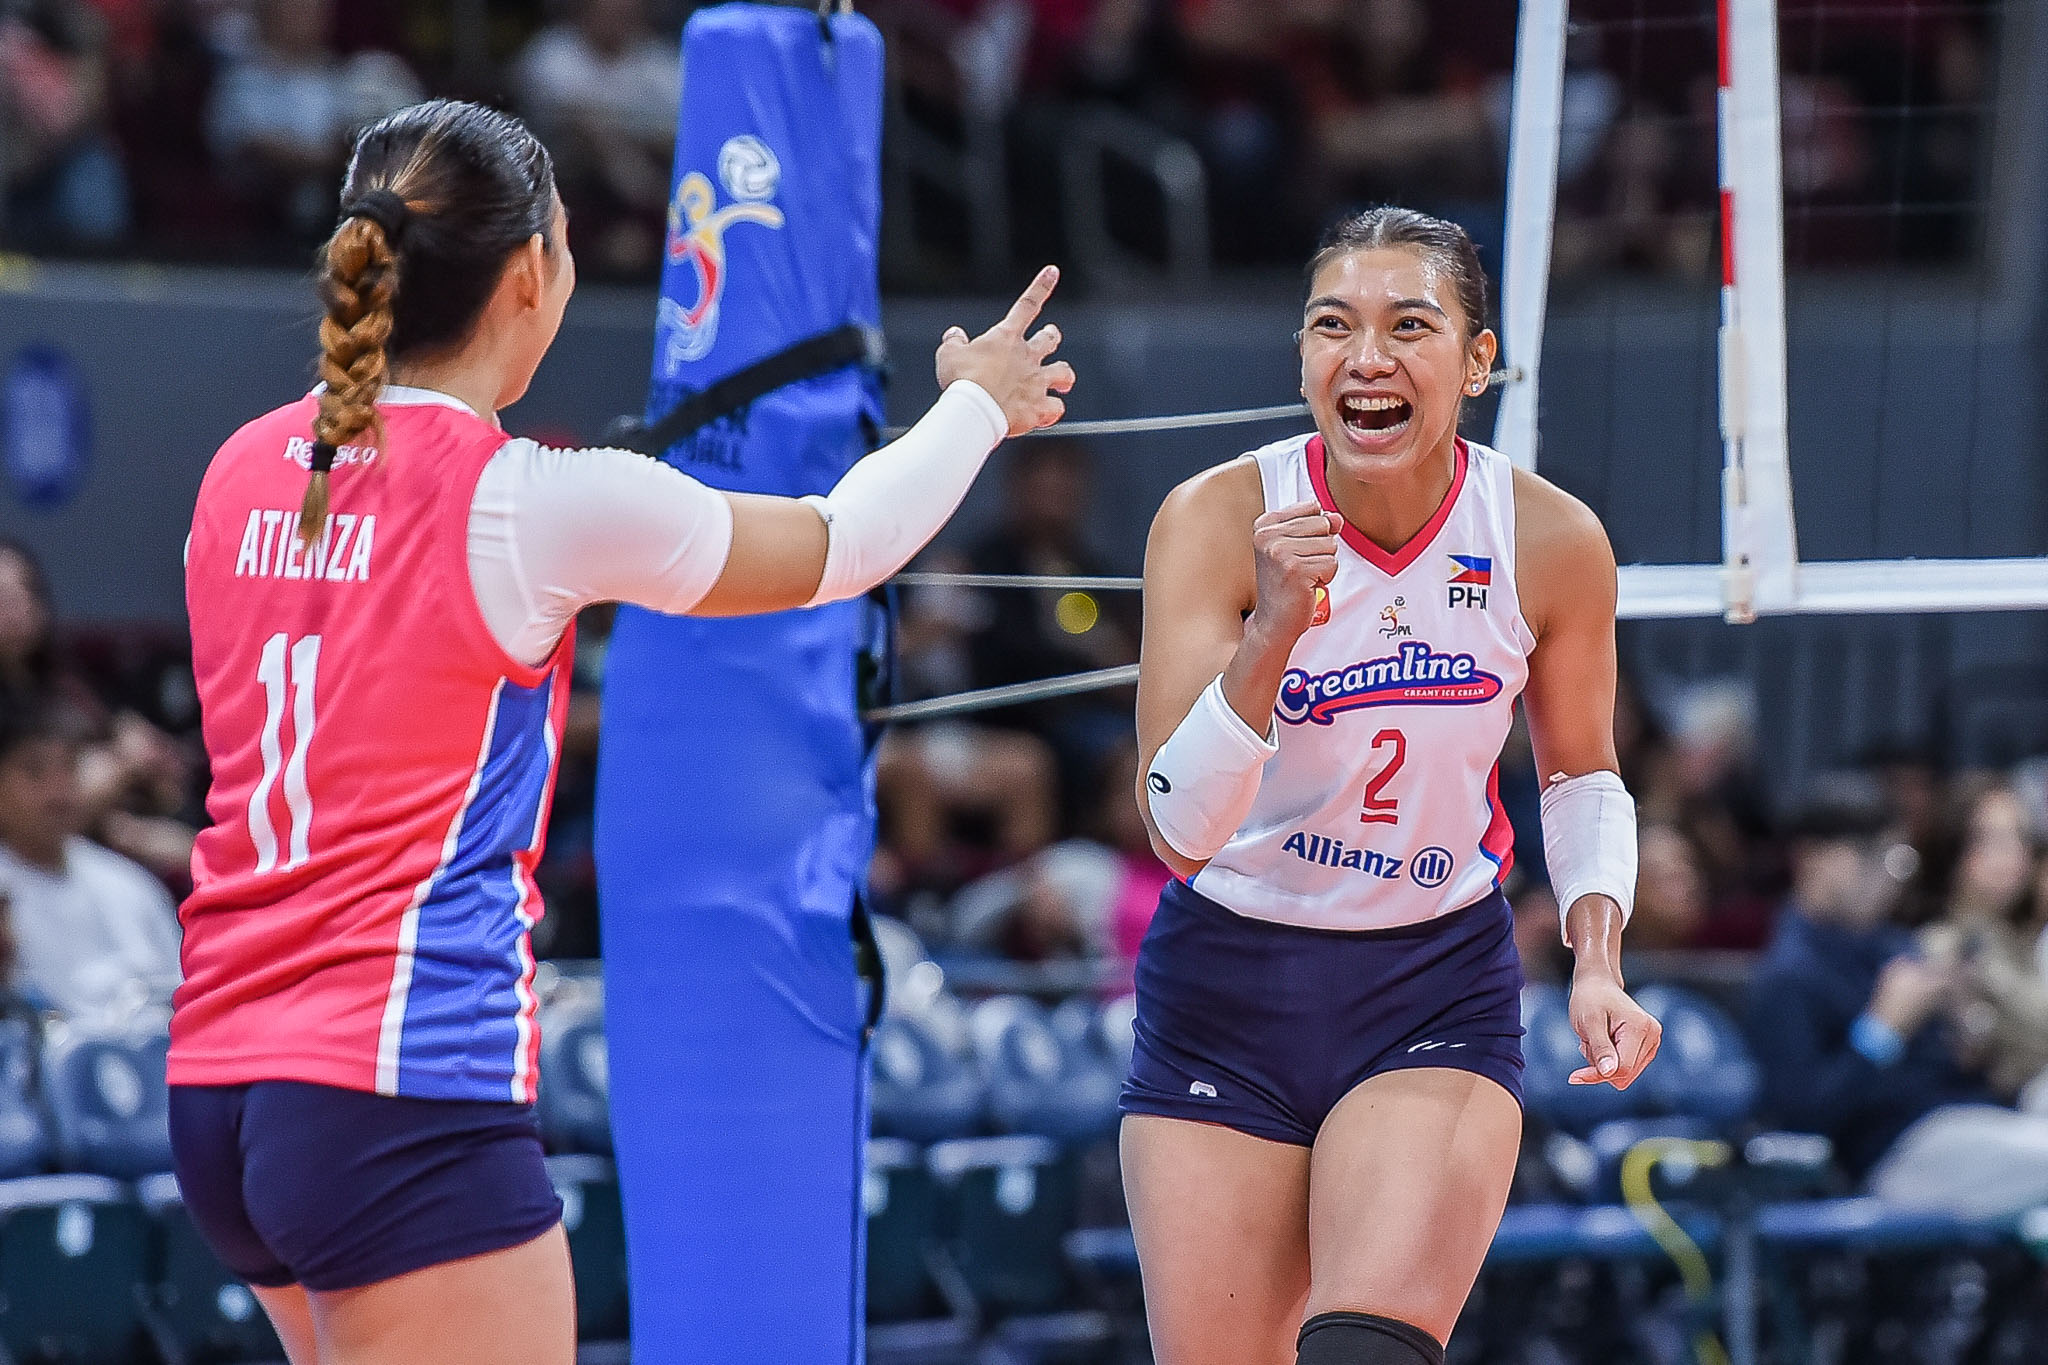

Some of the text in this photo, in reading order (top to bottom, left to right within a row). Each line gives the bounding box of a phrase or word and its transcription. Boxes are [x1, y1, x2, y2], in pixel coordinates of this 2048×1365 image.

[283, 436, 378, 471] Resco
[235, 509, 377, 582] ATIENZA
[1448, 586, 1487, 611] PHI
[1397, 625, 1412, 637] PVL
[1275, 645, 1472, 720] Creamline
[1403, 687, 1485, 697] CREAMY ICE CREAM
[248, 632, 323, 875] 11
[1362, 728, 1407, 810] 2
[1281, 831, 1404, 881] Allianz
